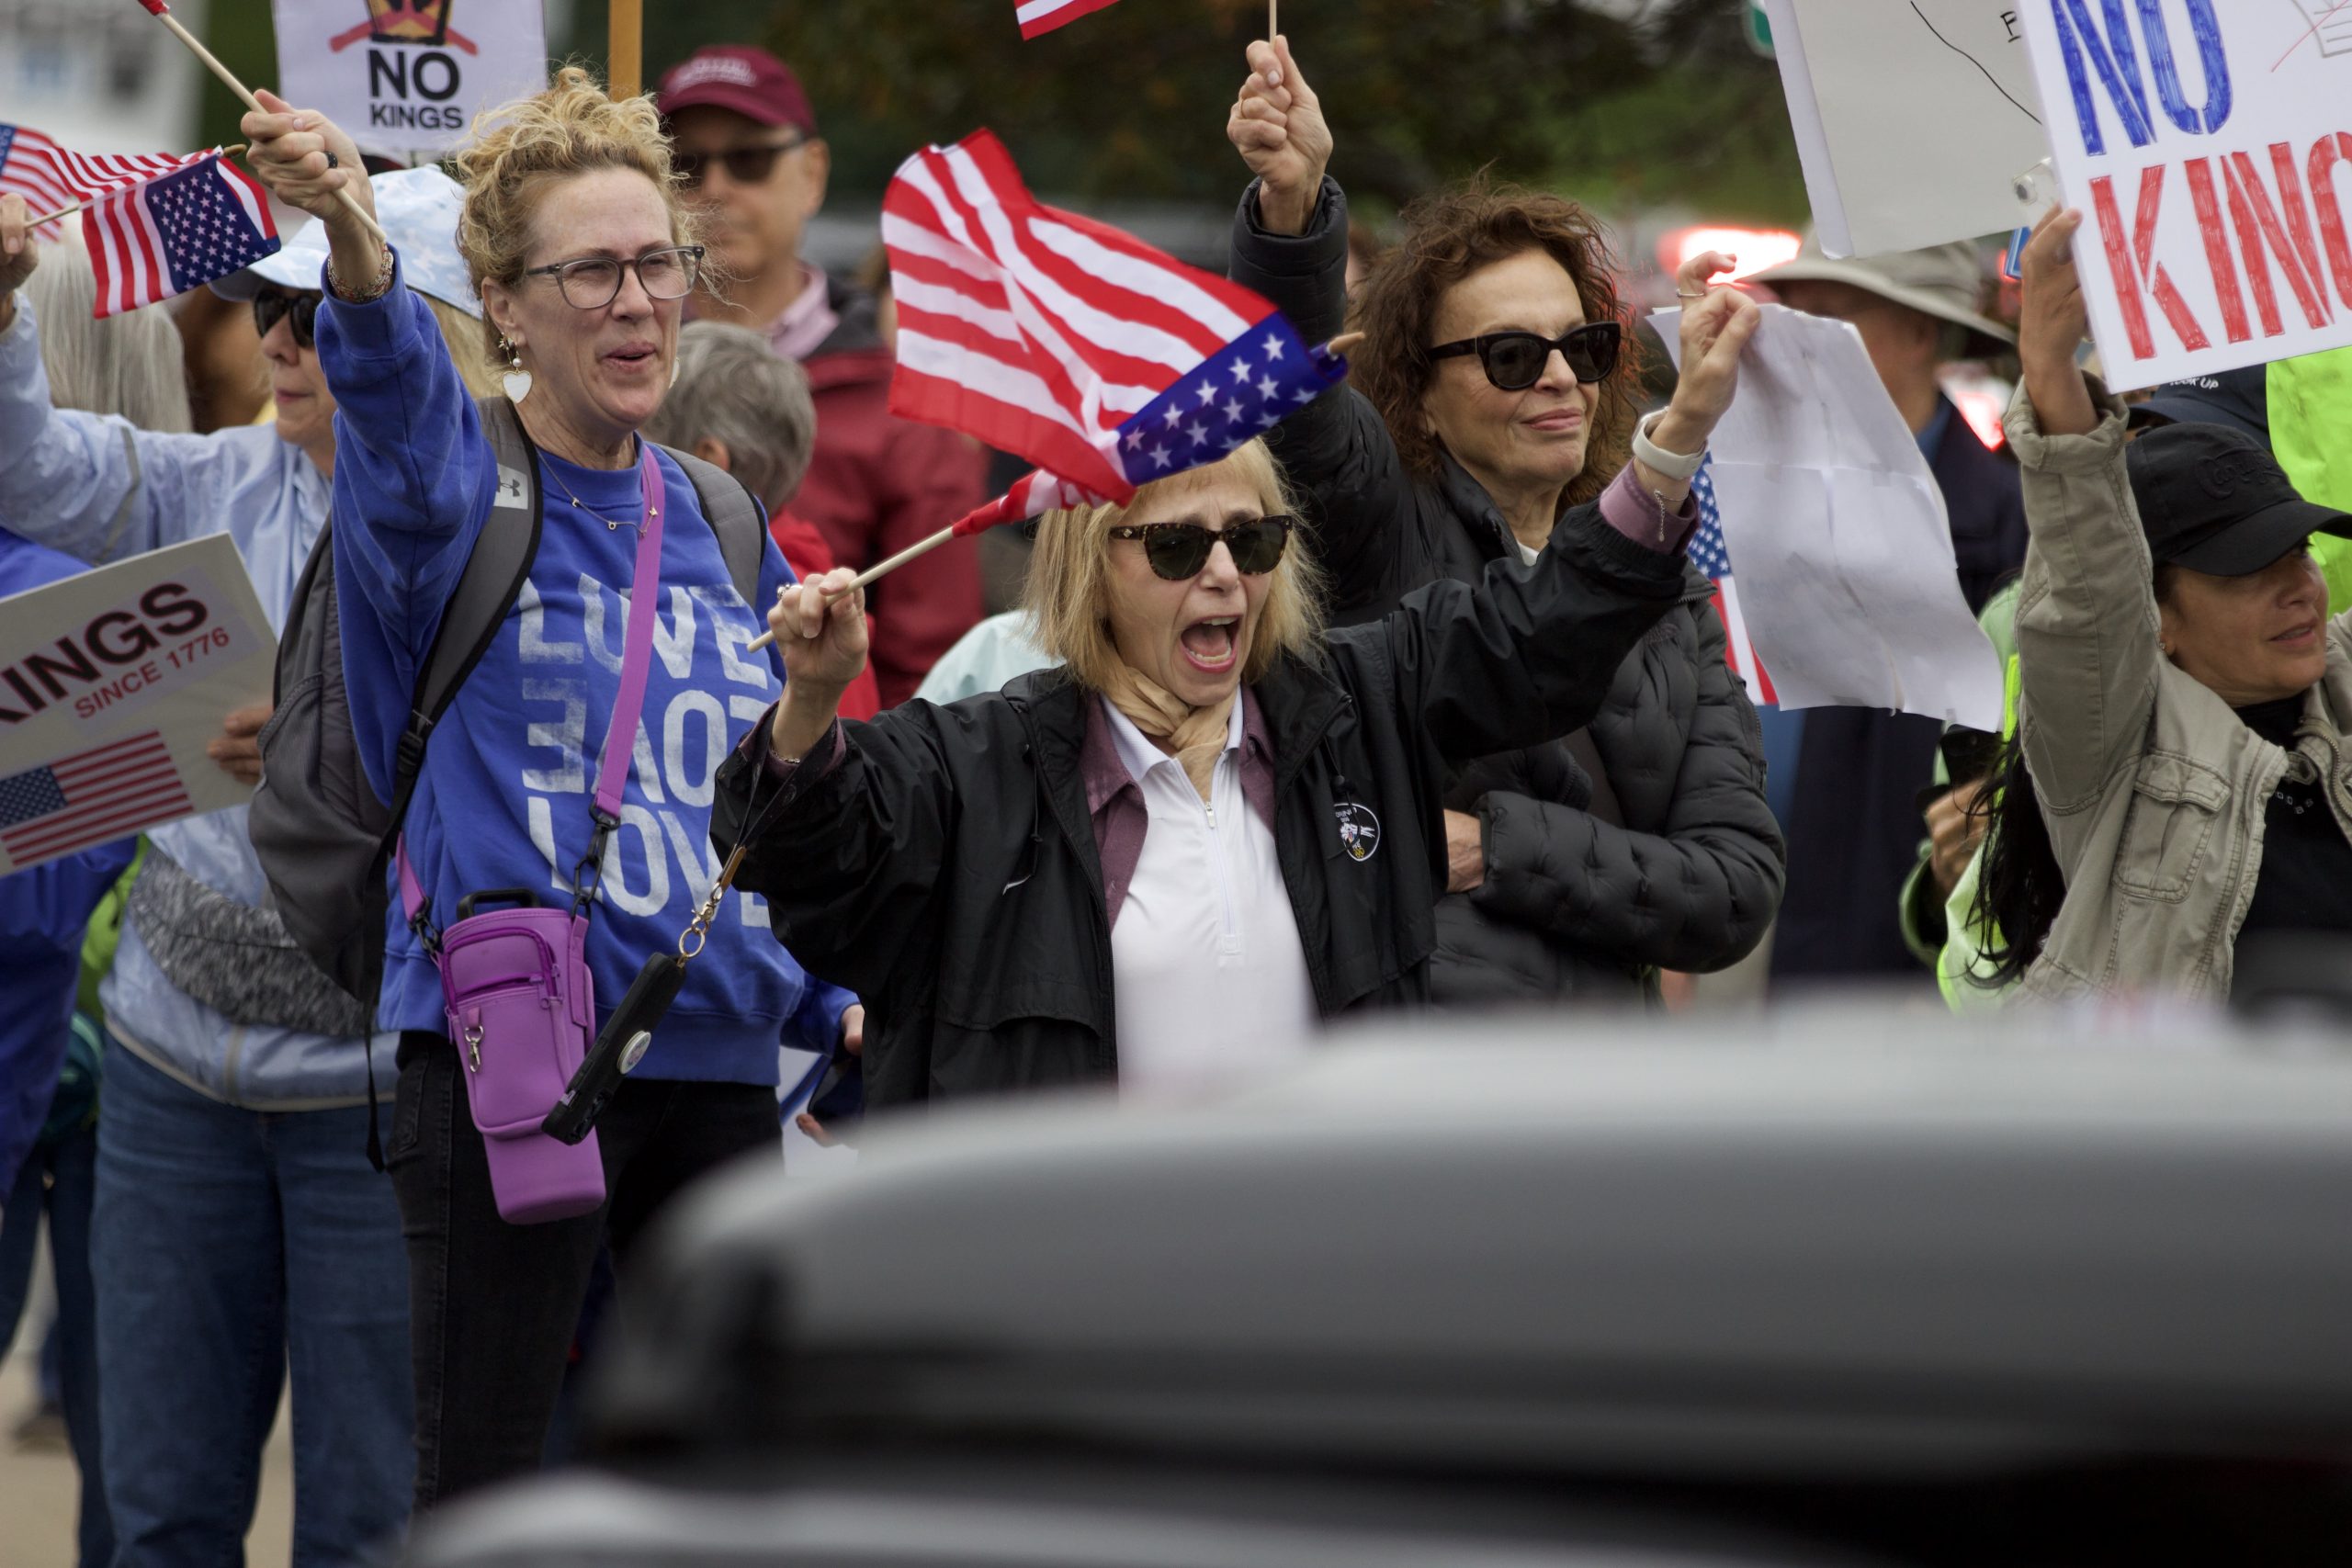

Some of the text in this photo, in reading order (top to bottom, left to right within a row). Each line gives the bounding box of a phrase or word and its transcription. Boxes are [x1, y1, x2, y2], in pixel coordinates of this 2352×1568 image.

[368, 49, 461, 103] NO
[369, 103, 464, 130] KINGS
[2200, 377, 2219, 389] UP
[74, 626, 230, 719] SINCE 1776
